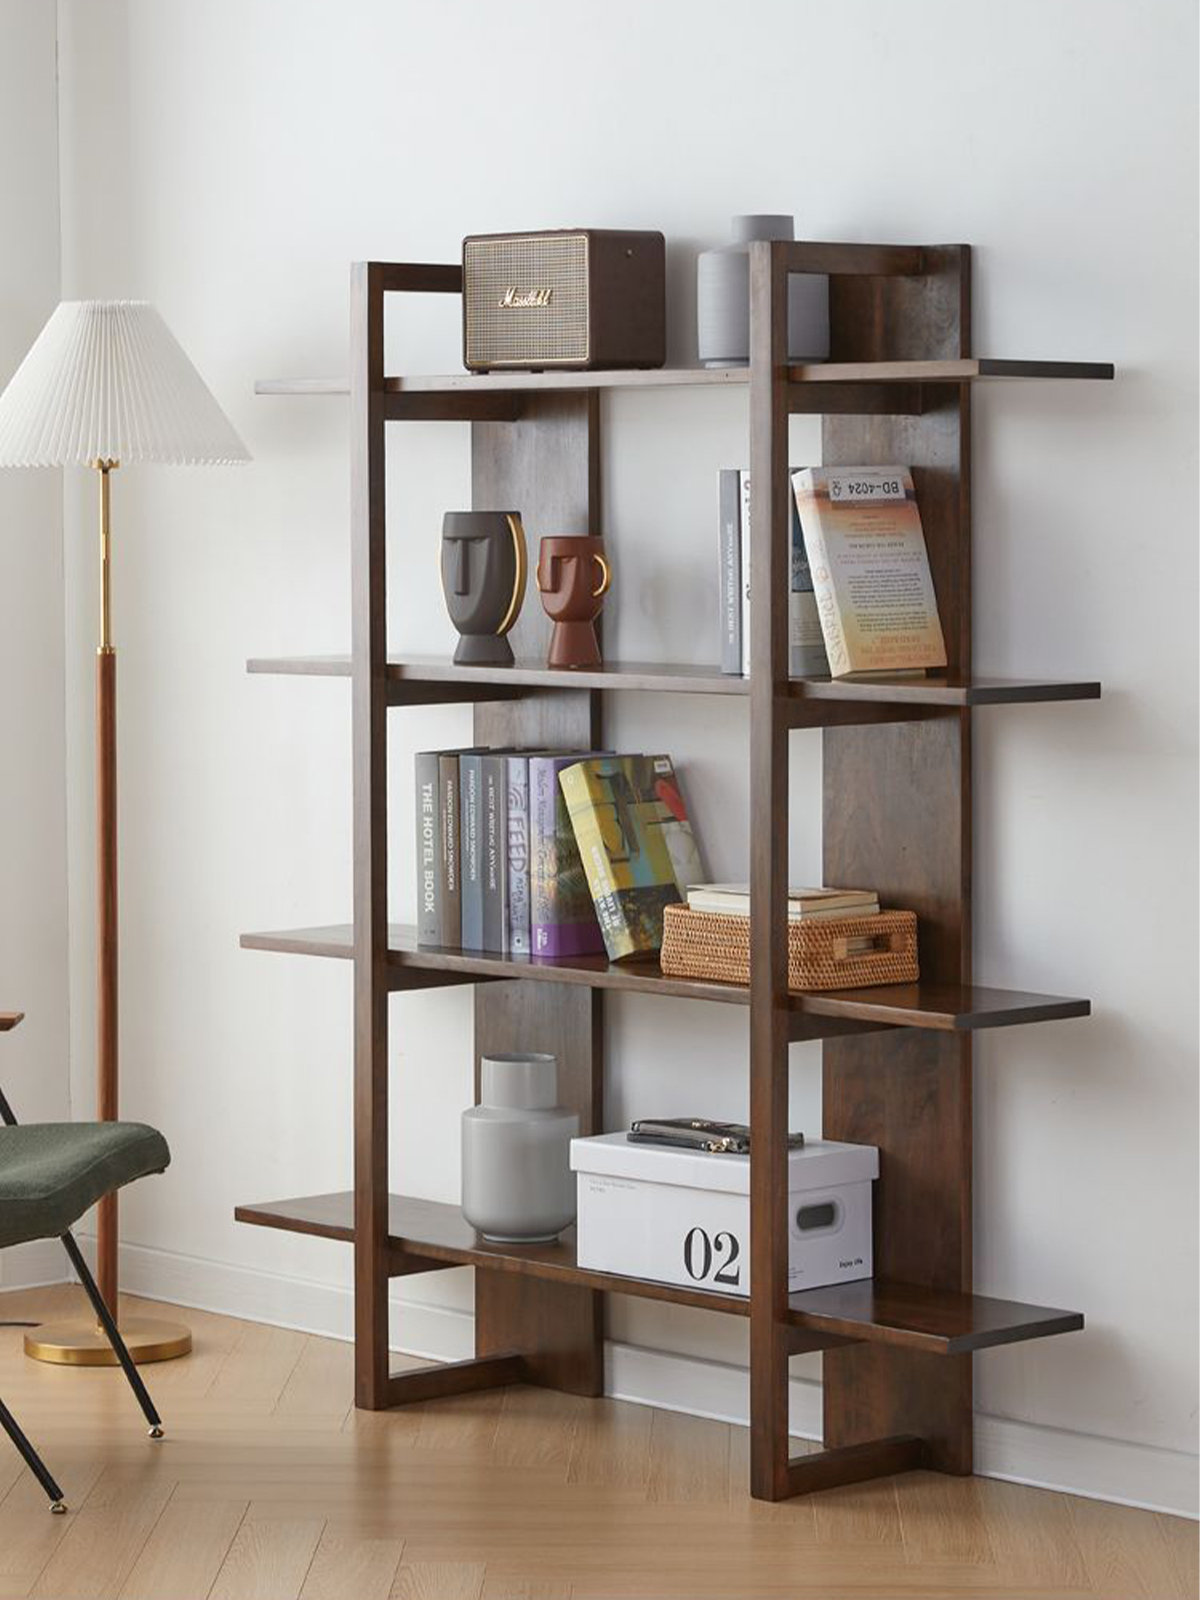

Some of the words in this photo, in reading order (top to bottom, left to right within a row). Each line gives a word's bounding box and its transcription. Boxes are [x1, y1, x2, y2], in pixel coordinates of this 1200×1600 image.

[848, 481, 900, 495] BD-4024
[421, 783, 433, 813] THE
[423, 817, 434, 866] HOTEL
[509, 816, 526, 873] FEED
[424, 871, 435, 912] BOOK
[684, 1226, 740, 1286] 02
